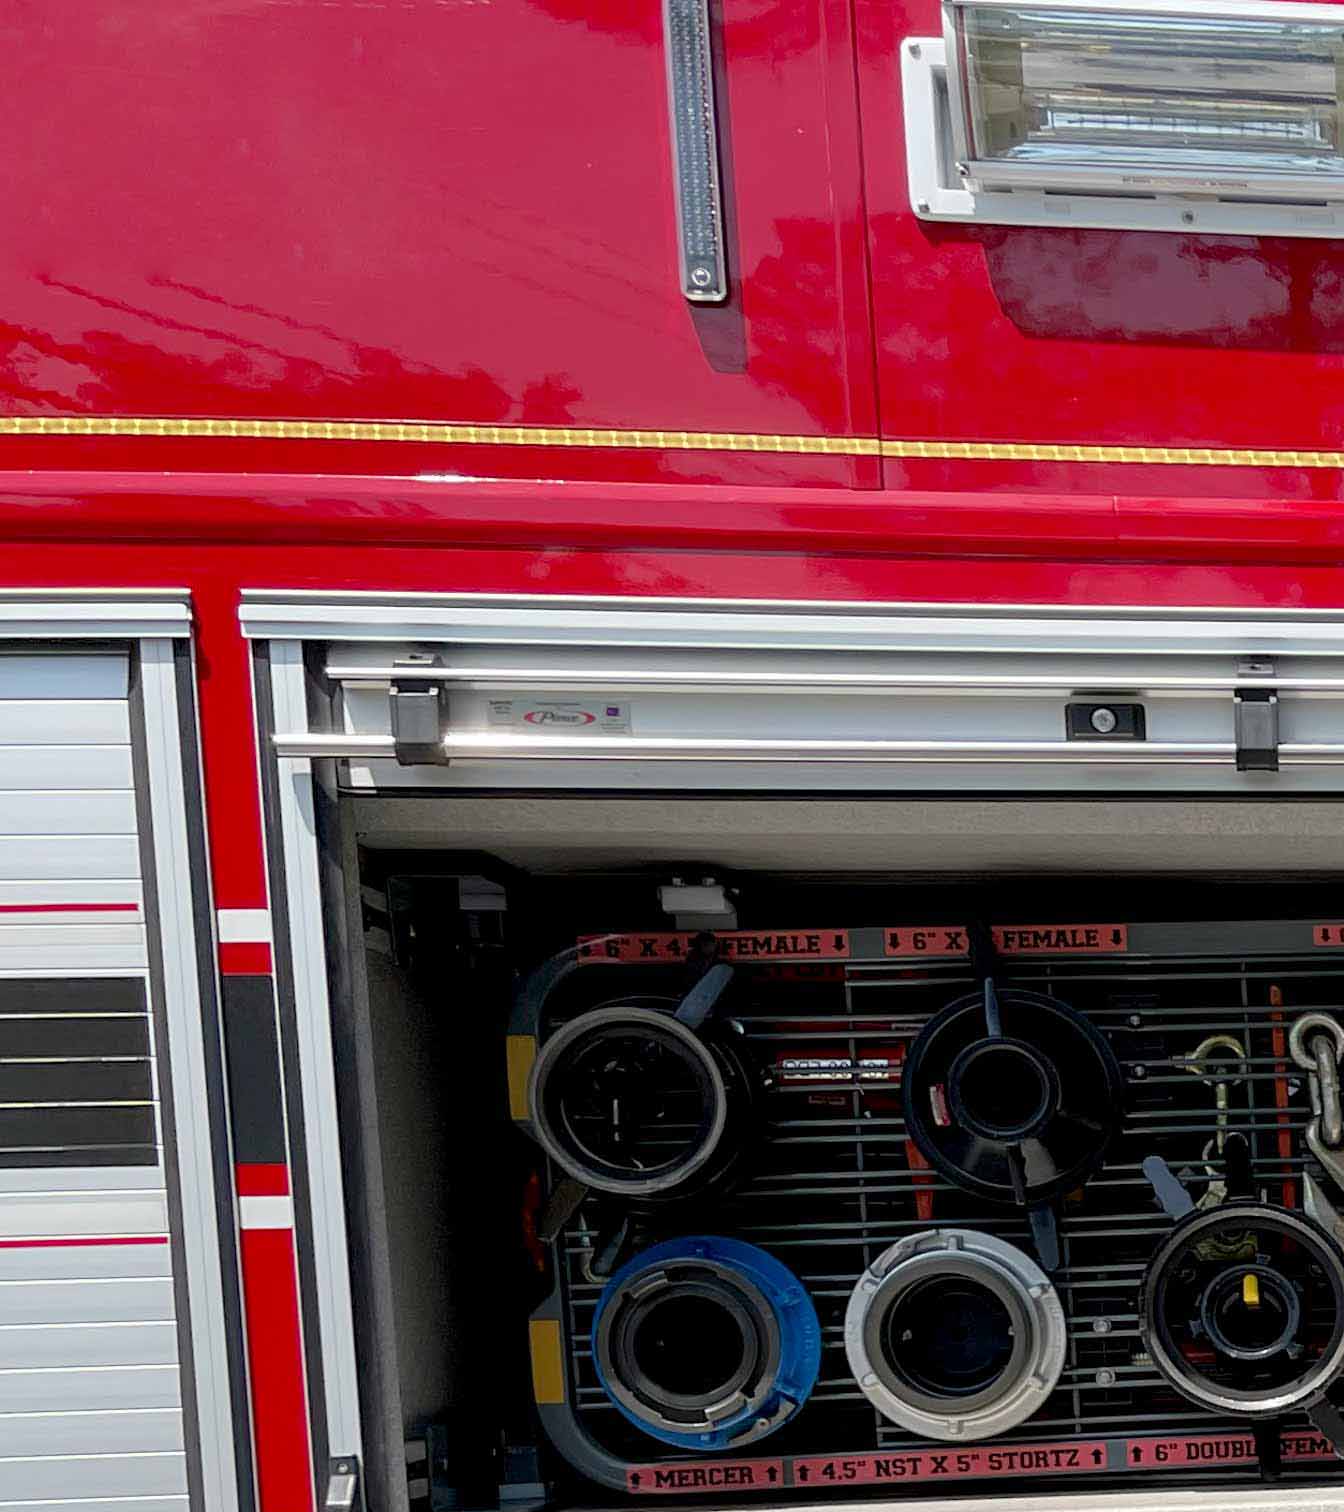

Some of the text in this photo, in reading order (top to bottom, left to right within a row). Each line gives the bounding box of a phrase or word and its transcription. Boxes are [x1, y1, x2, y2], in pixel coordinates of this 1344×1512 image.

[722, 935, 821, 955] FEMALE
[913, 929, 1099, 950] 6" X FEMALE
[1155, 1442, 1178, 1462] 6"
[1186, 1438, 1258, 1461] DOUBL
[821, 1448, 1080, 1481] 4.5" NST X 5" STORTZ
[655, 1465, 755, 1489] MERCER
